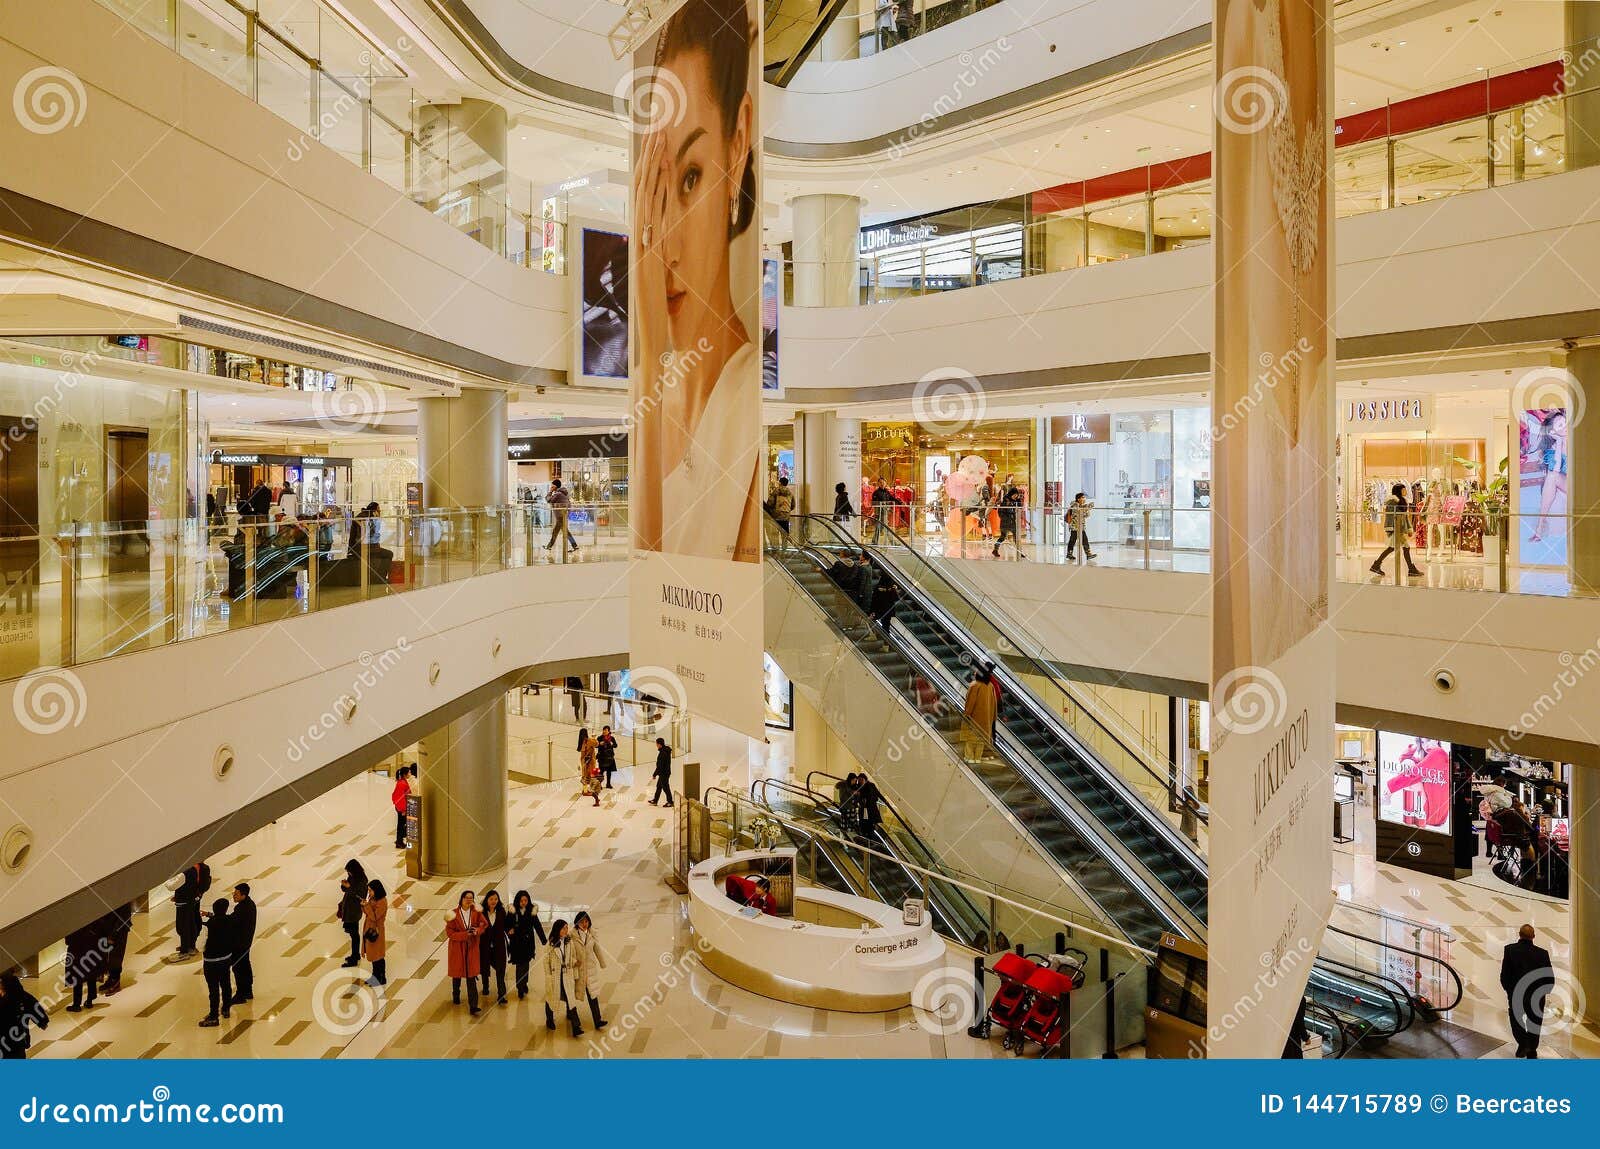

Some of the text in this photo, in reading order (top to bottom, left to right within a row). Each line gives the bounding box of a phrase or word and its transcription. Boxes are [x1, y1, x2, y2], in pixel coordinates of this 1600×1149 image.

[860, 228, 890, 250] LOHO
[890, 228, 930, 244] COLLECTION
[72, 456, 88, 478] L4
[855, 943, 897, 954] Concierge
[1166, 936, 1176, 947] L3
